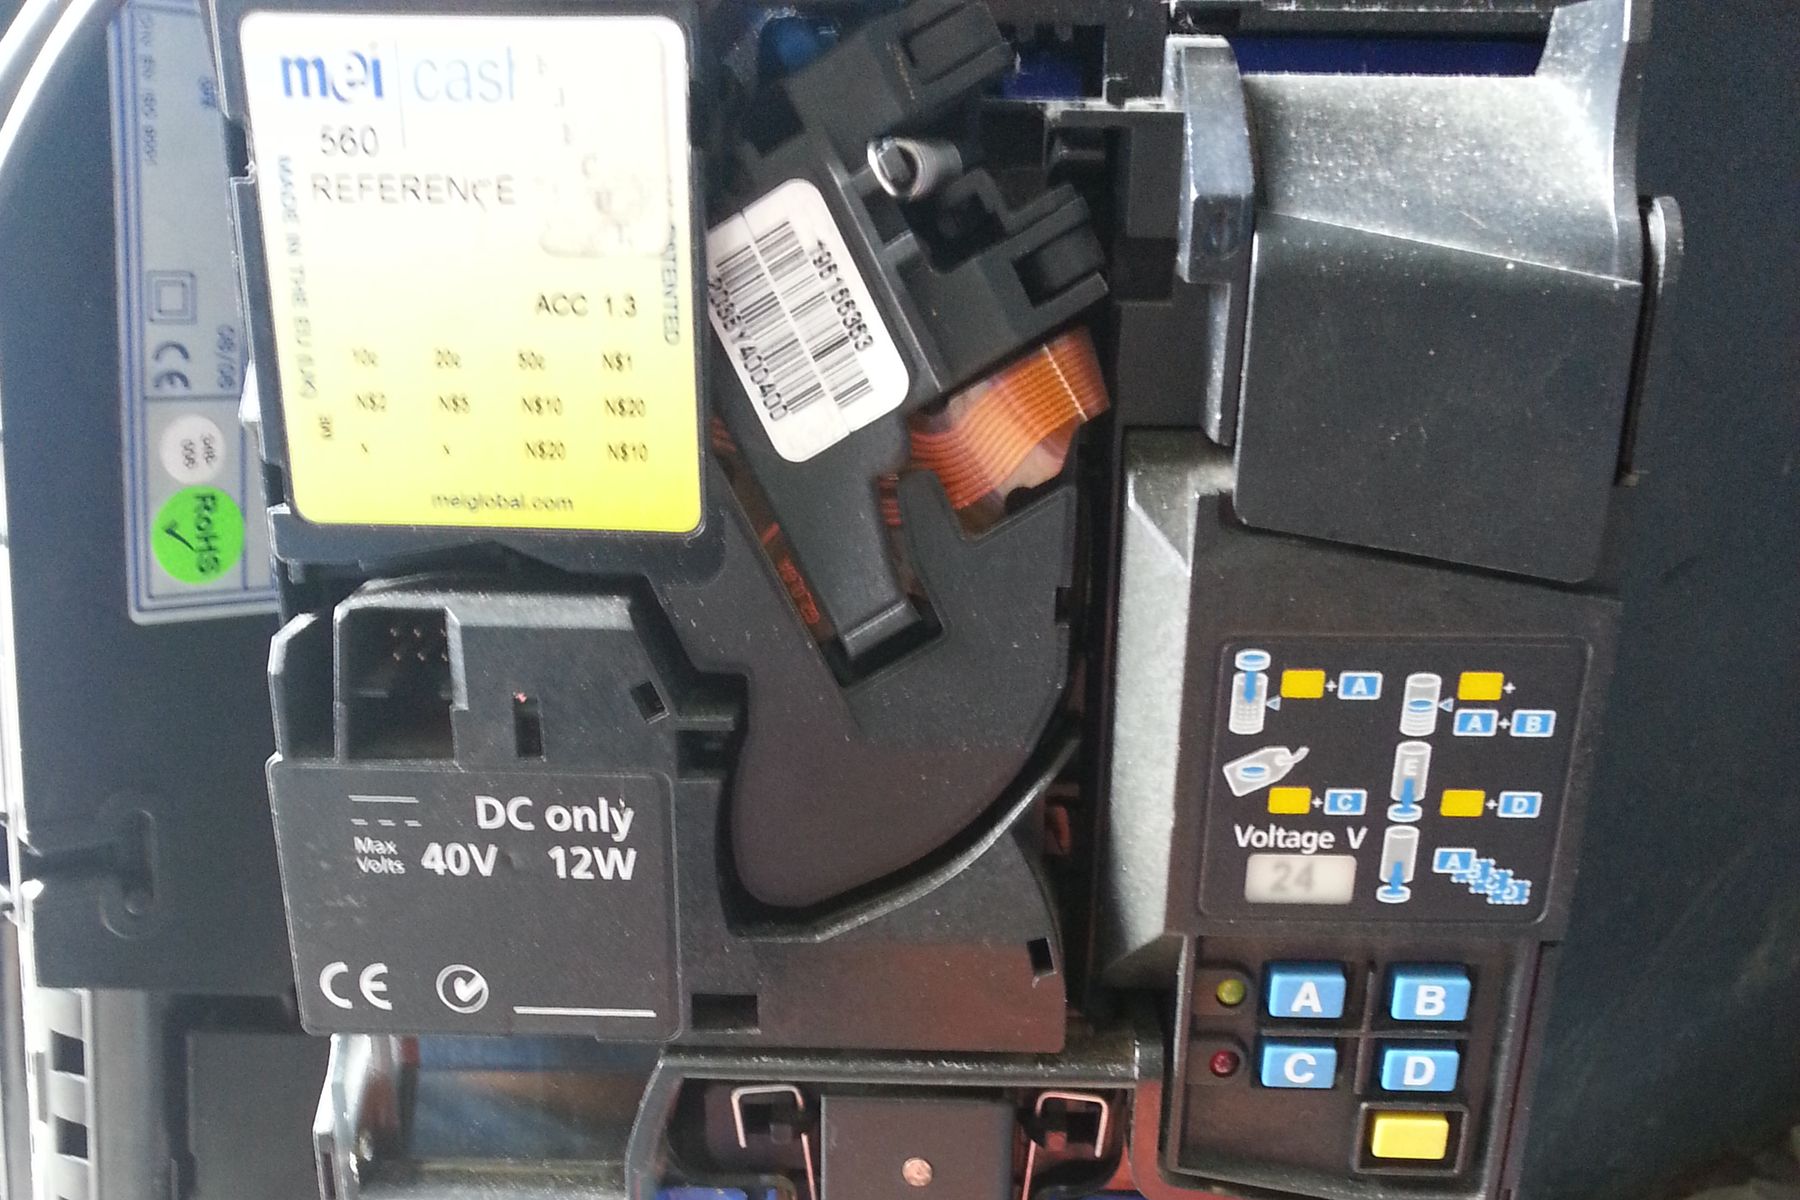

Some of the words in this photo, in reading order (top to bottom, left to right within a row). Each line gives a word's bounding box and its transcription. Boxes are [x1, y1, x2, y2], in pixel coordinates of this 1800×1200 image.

[320, 126, 379, 156] 560
[310, 174, 516, 208] REFERENCE
[535, 294, 588, 316] ACC
[431, 493, 575, 513] meiglobal.com
[474, 795, 535, 831] DC
[545, 796, 635, 843] only
[354, 836, 398, 855] Max
[1233, 824, 1335, 854] Voltage
[1346, 827, 1368, 849] V
[357, 856, 406, 875] Volts
[420, 842, 499, 877] 40V
[547, 846, 637, 881] 12W
[1273, 864, 1316, 892] 24
[1290, 982, 1323, 1013] A
[1414, 985, 1446, 1016] B
[1284, 1053, 1317, 1084] C
[1403, 1056, 1435, 1087] D
